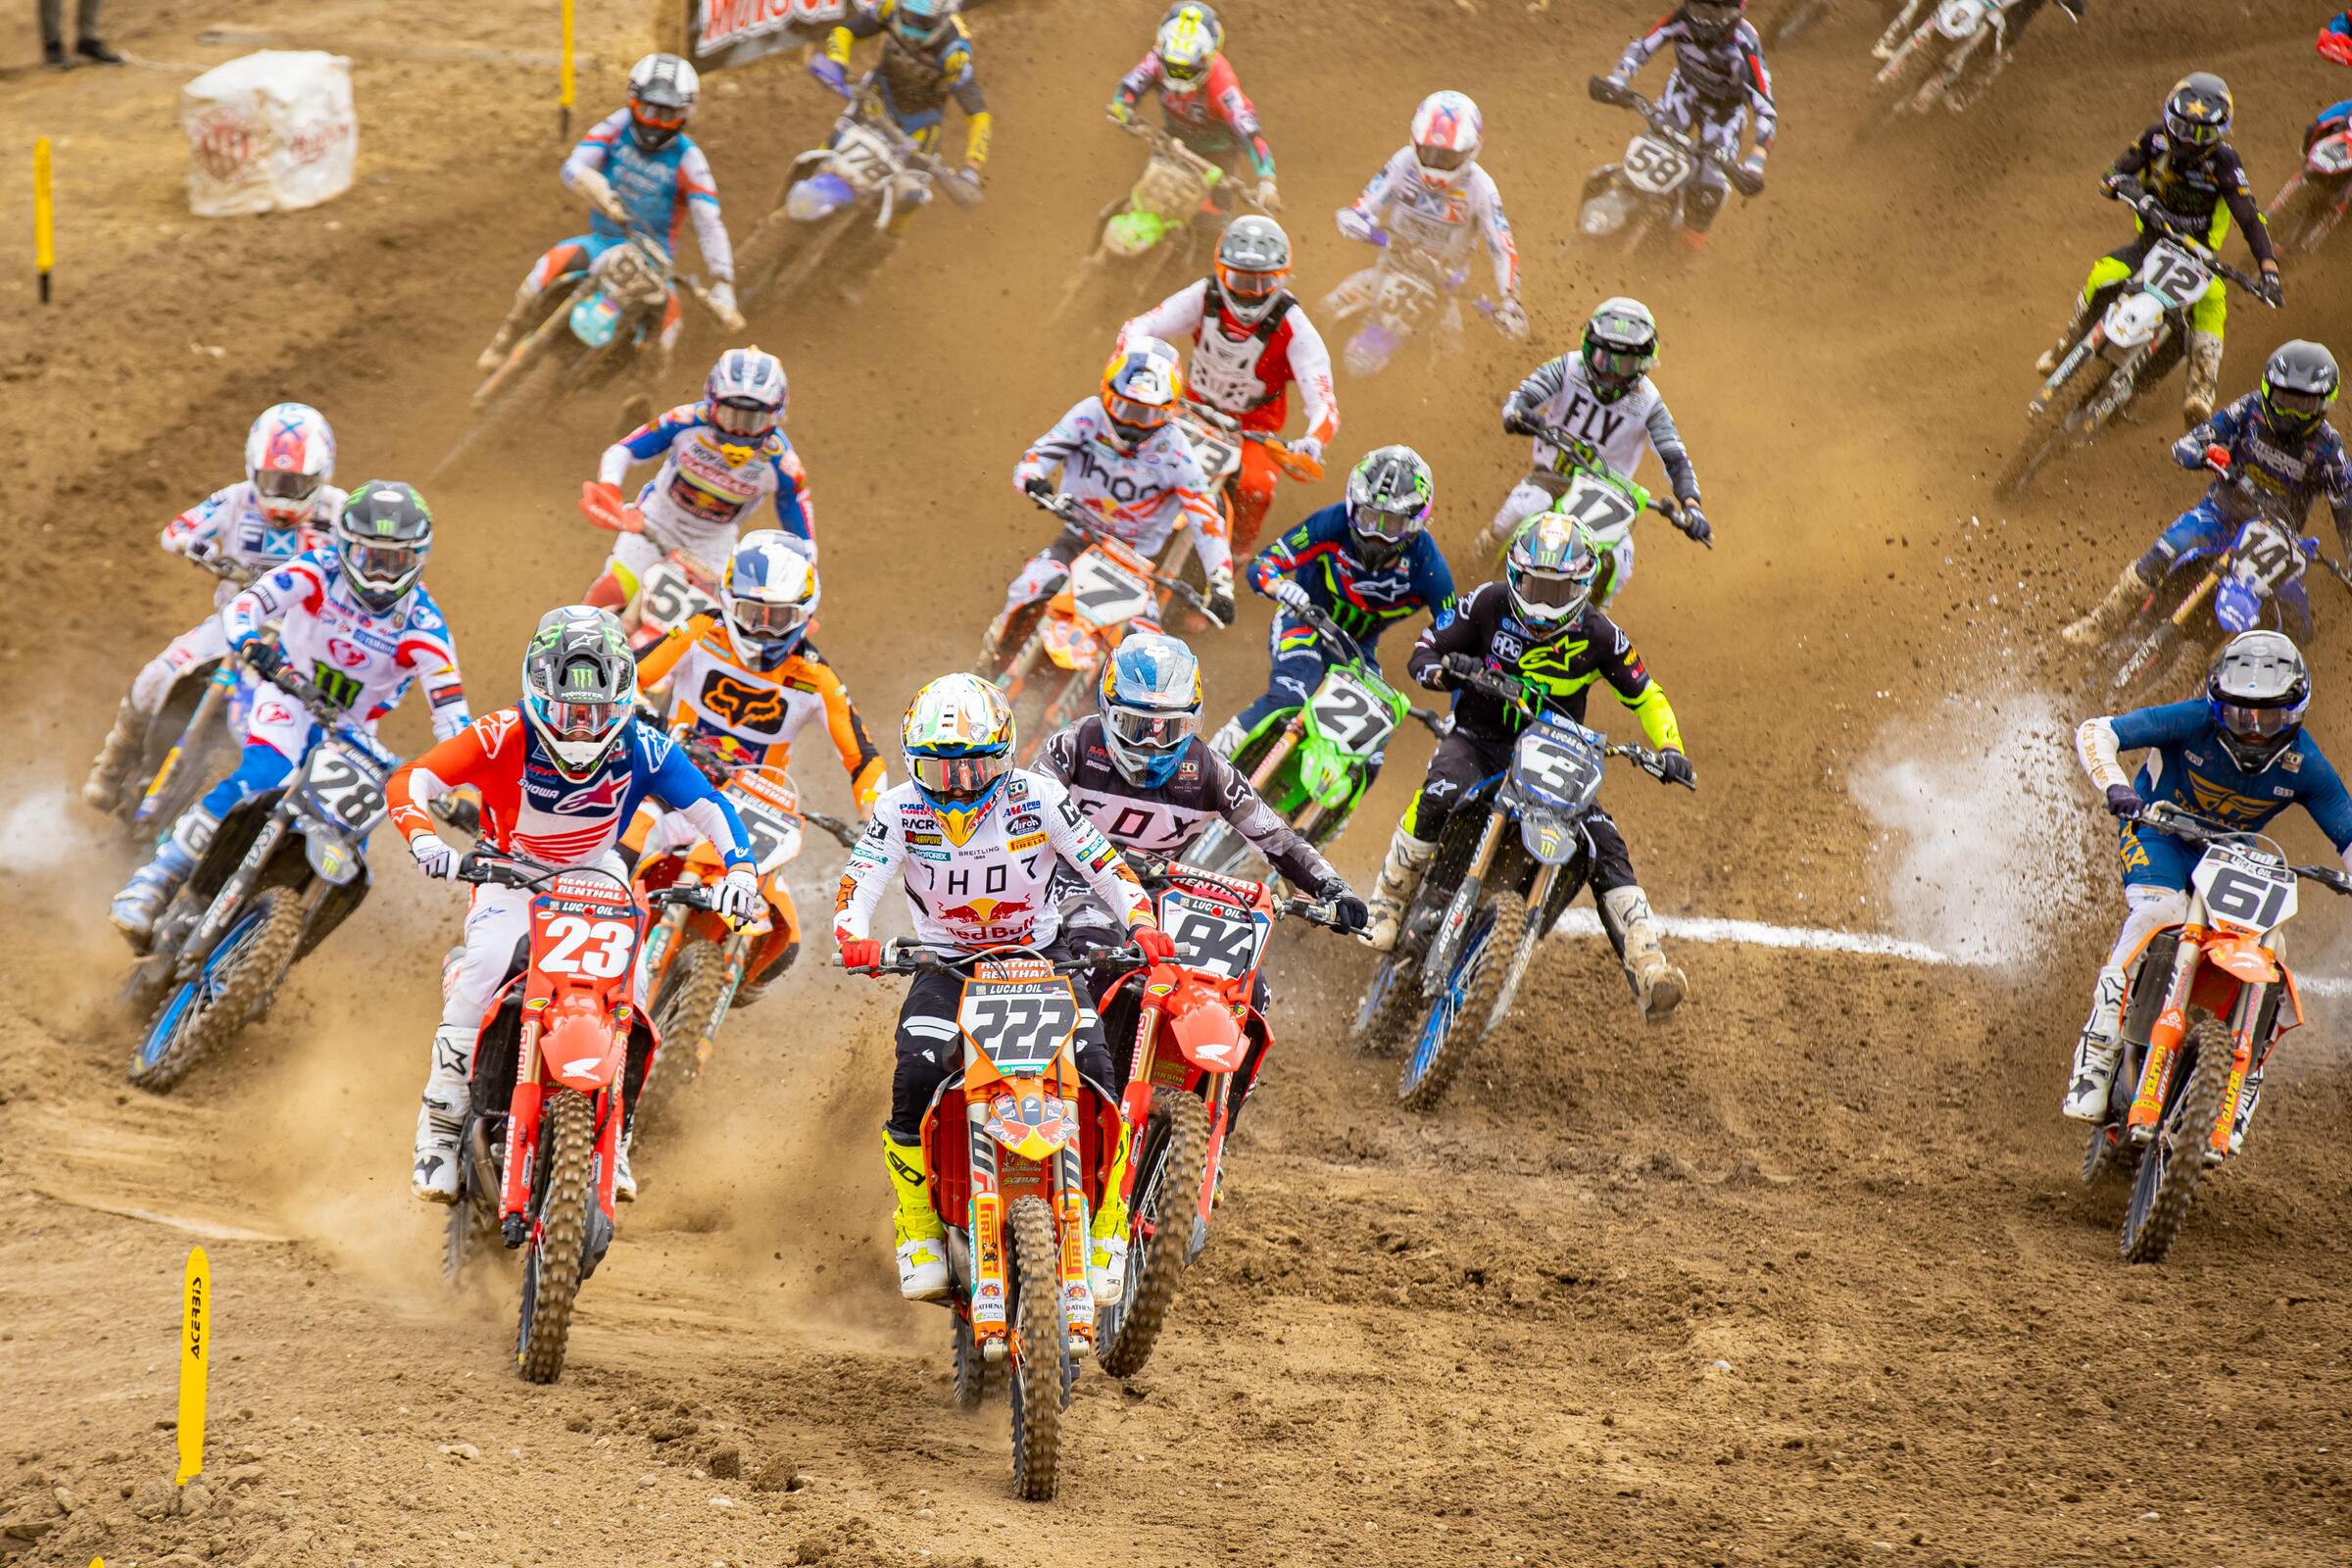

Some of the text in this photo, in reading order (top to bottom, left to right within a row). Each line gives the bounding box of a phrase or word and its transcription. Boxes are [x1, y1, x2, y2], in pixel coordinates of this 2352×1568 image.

[1628, 146, 1682, 185] 58
[2153, 255, 2202, 305] 12
[1562, 393, 1625, 446] FLY
[1567, 489, 1632, 532] 17
[2233, 532, 2303, 588] 141
[1075, 566, 1142, 609] 7
[1315, 688, 1387, 752] 21
[311, 760, 385, 826] 28
[515, 778, 560, 800] SHOWA
[1522, 742, 1598, 804] 3
[1003, 803, 1027, 818] AMA
[1009, 815, 1039, 832] Airoh
[1076, 798, 1200, 842] FOX
[957, 845, 1000, 857] BREITLING
[556, 884, 621, 901] RENTHAL
[1175, 863, 1260, 894] RENTHAL
[2206, 867, 2289, 929] 61
[562, 901, 614, 916] LUCS OIL
[1192, 900, 1241, 919] LUCS OIL
[1438, 891, 1468, 954] DUNLOP
[537, 916, 635, 979] 23
[1174, 913, 1253, 979] 94
[981, 969, 1050, 980] RENTHAL
[989, 983, 1044, 995] LUCAS OIL
[1192, 967, 1221, 978] HONDA
[971, 998, 1076, 1060] 222
[562, 1070, 602, 1083] HONDA
[1195, 1053, 1232, 1068] HONDA
[2158, 1050, 2175, 1102] DUNLOP
[500, 1114, 516, 1199] DUNLOP
[980, 1203, 999, 1273] PIREI
[190, 1276, 202, 1360] ACERBIS
